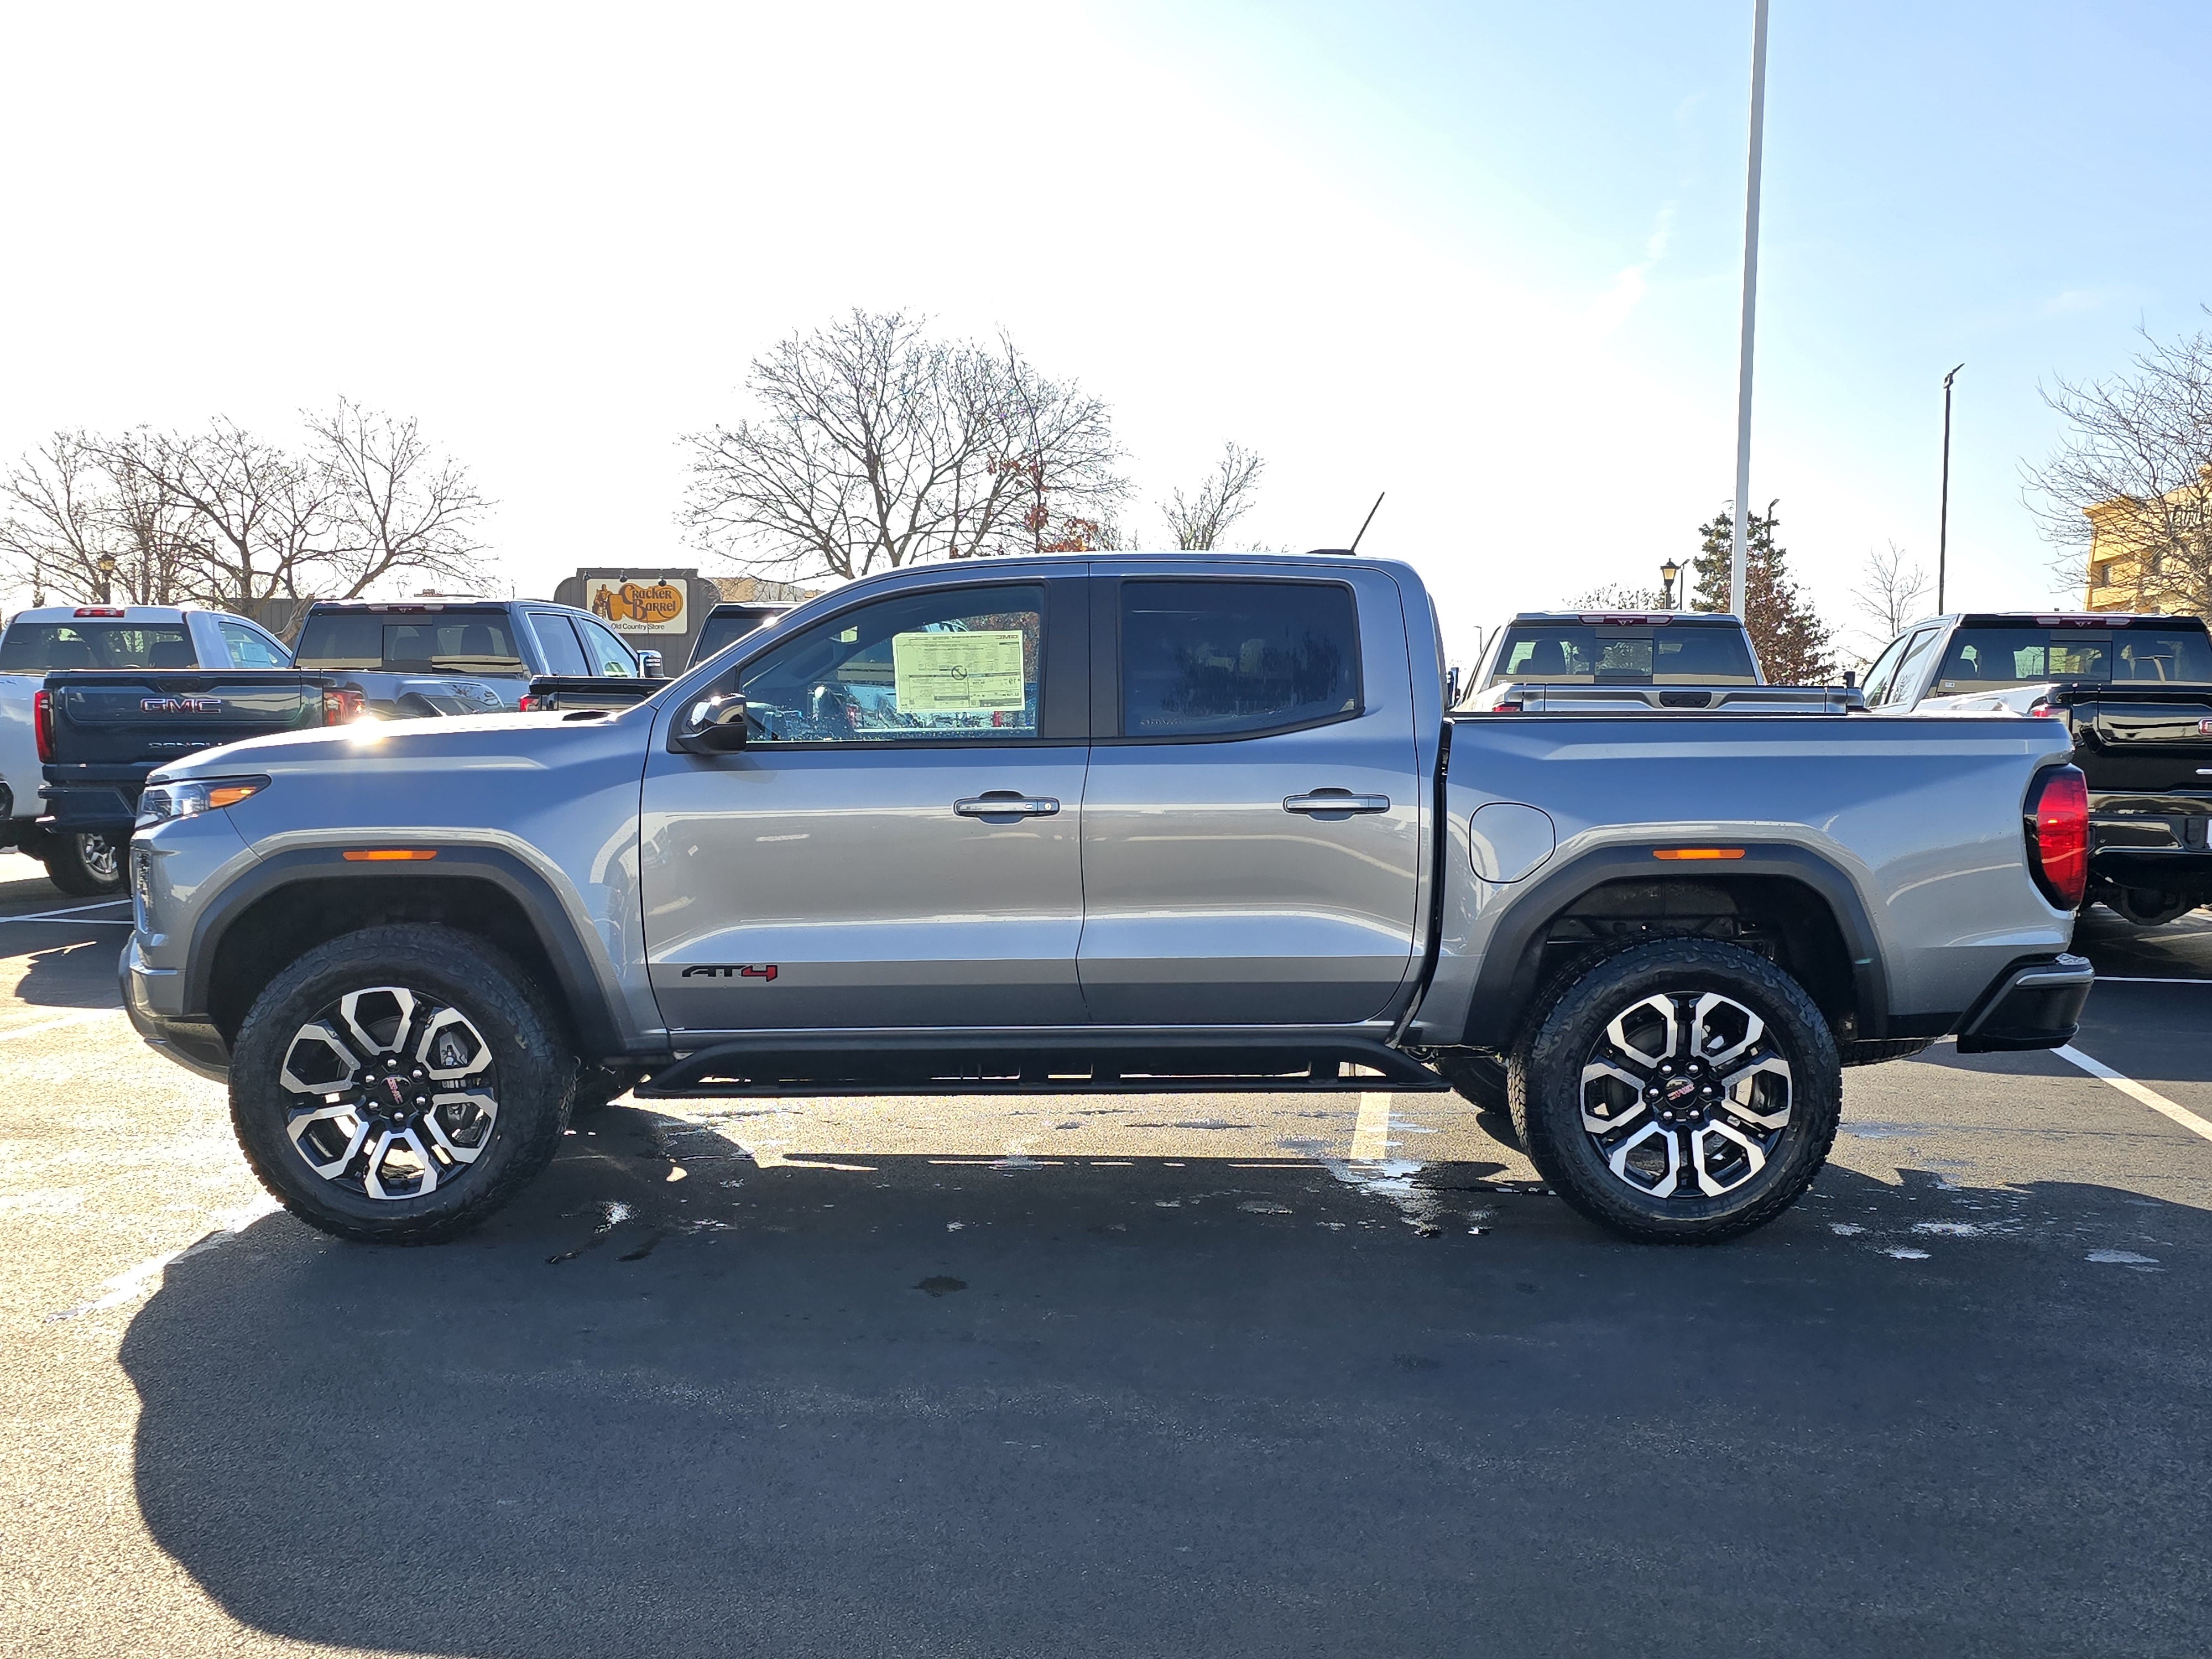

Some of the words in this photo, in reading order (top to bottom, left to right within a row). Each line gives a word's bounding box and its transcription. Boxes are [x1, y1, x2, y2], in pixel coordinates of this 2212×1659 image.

[619, 585, 672, 605] Cracker
[632, 599, 676, 620] Barrel
[140, 698, 221, 713] GMC
[682, 964, 778, 983] AT4
